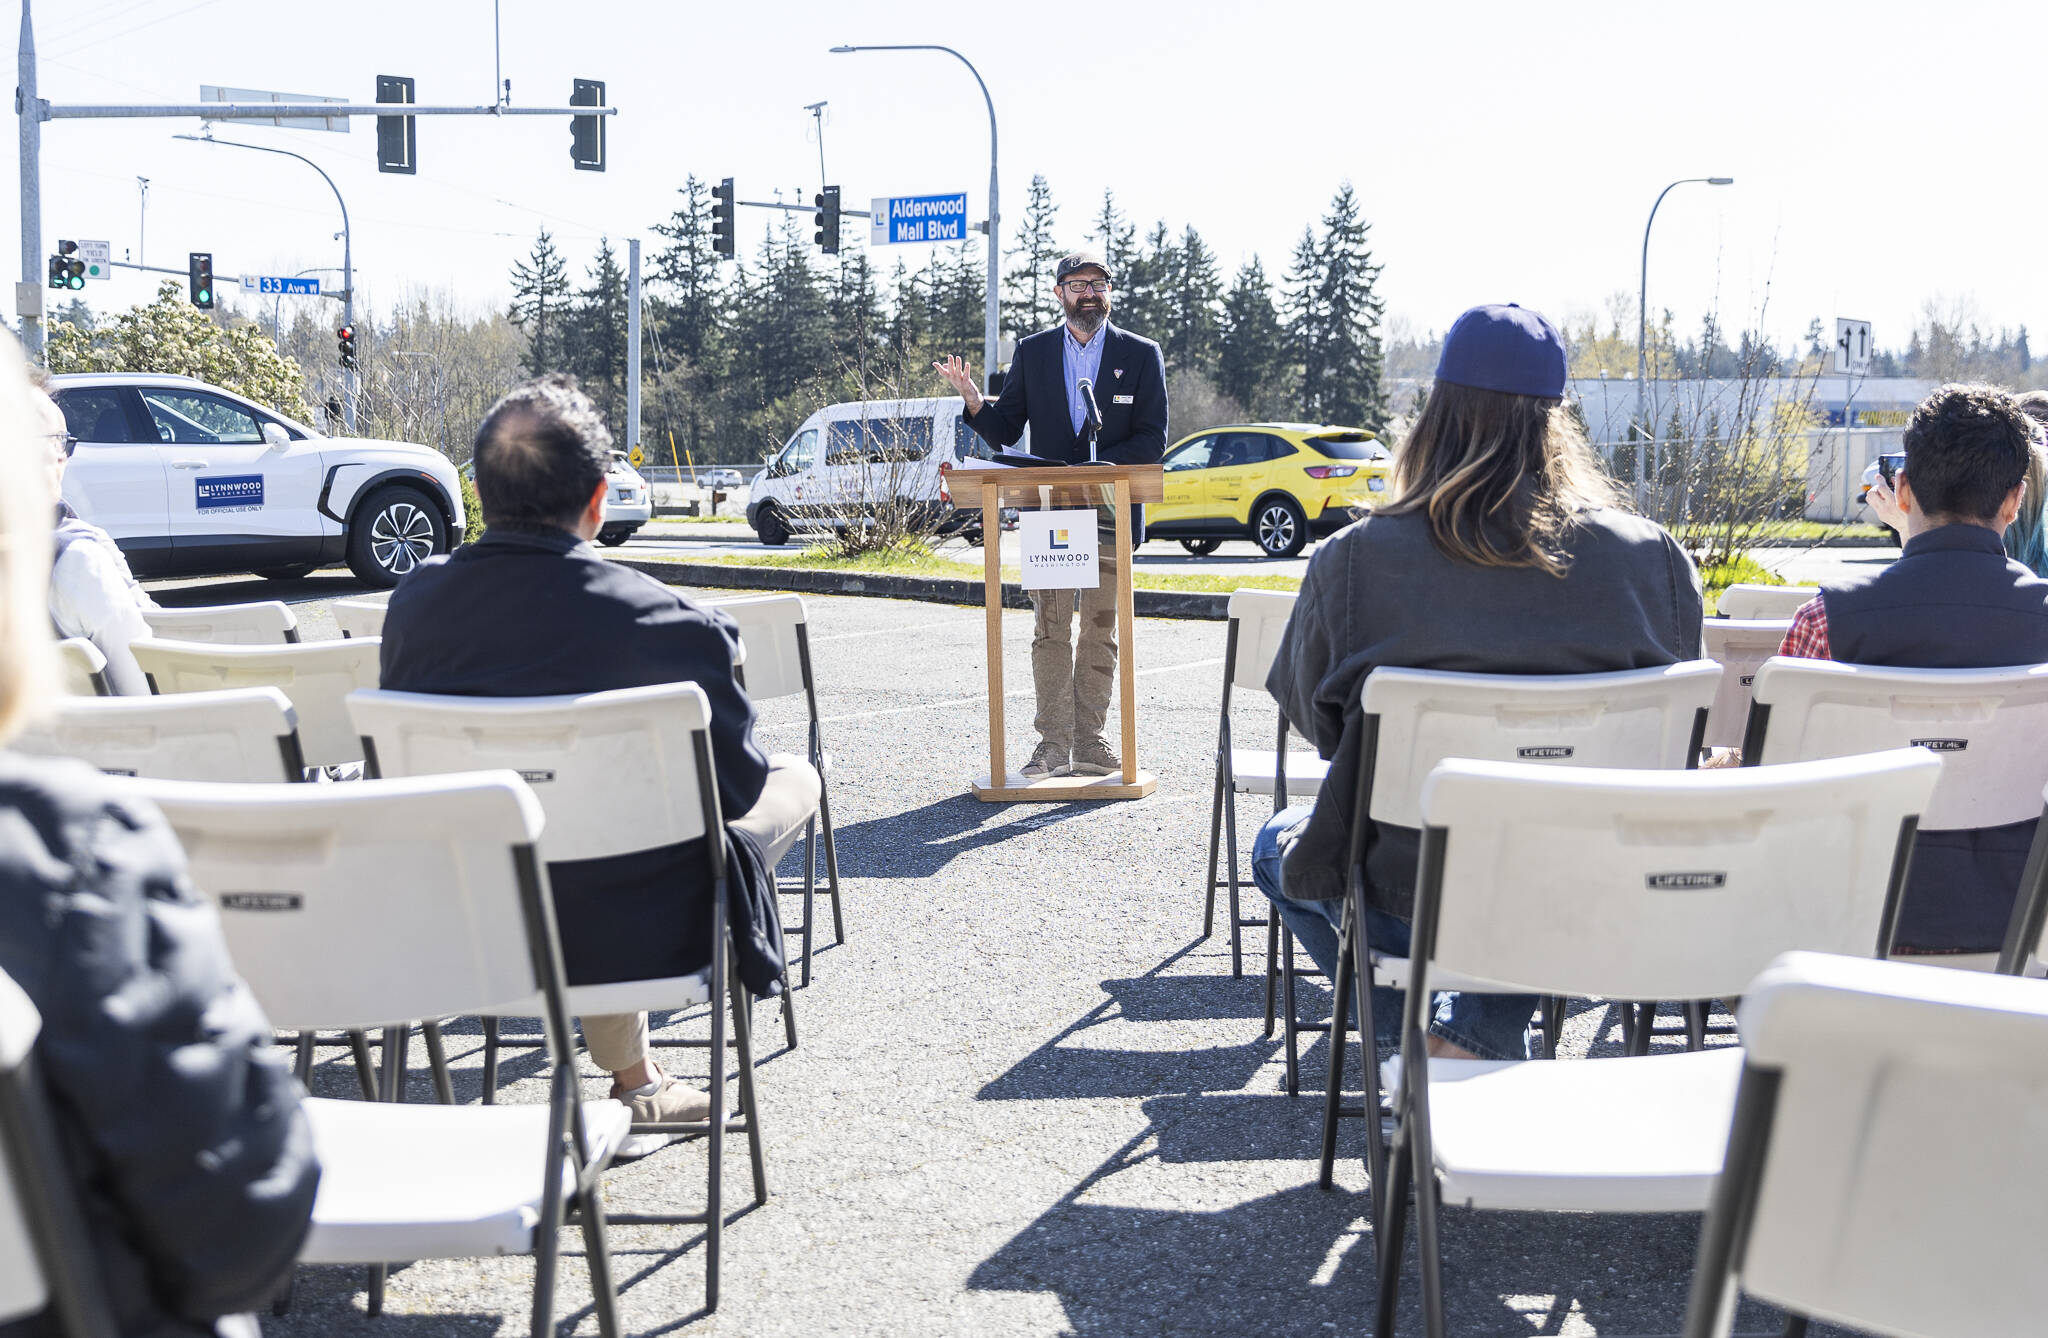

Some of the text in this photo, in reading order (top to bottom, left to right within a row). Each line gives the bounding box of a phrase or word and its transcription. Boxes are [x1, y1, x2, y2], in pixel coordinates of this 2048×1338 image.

[892, 195, 964, 218] Alderwood
[897, 219, 958, 241] Mall Blvd
[262, 278, 318, 294] 33 Ave W
[210, 482, 262, 491] LYNNWOOD
[1029, 553, 1090, 563] LYNNWOOD
[1524, 748, 1566, 756] LIFETIME
[1656, 875, 1715, 885] LIFETIME
